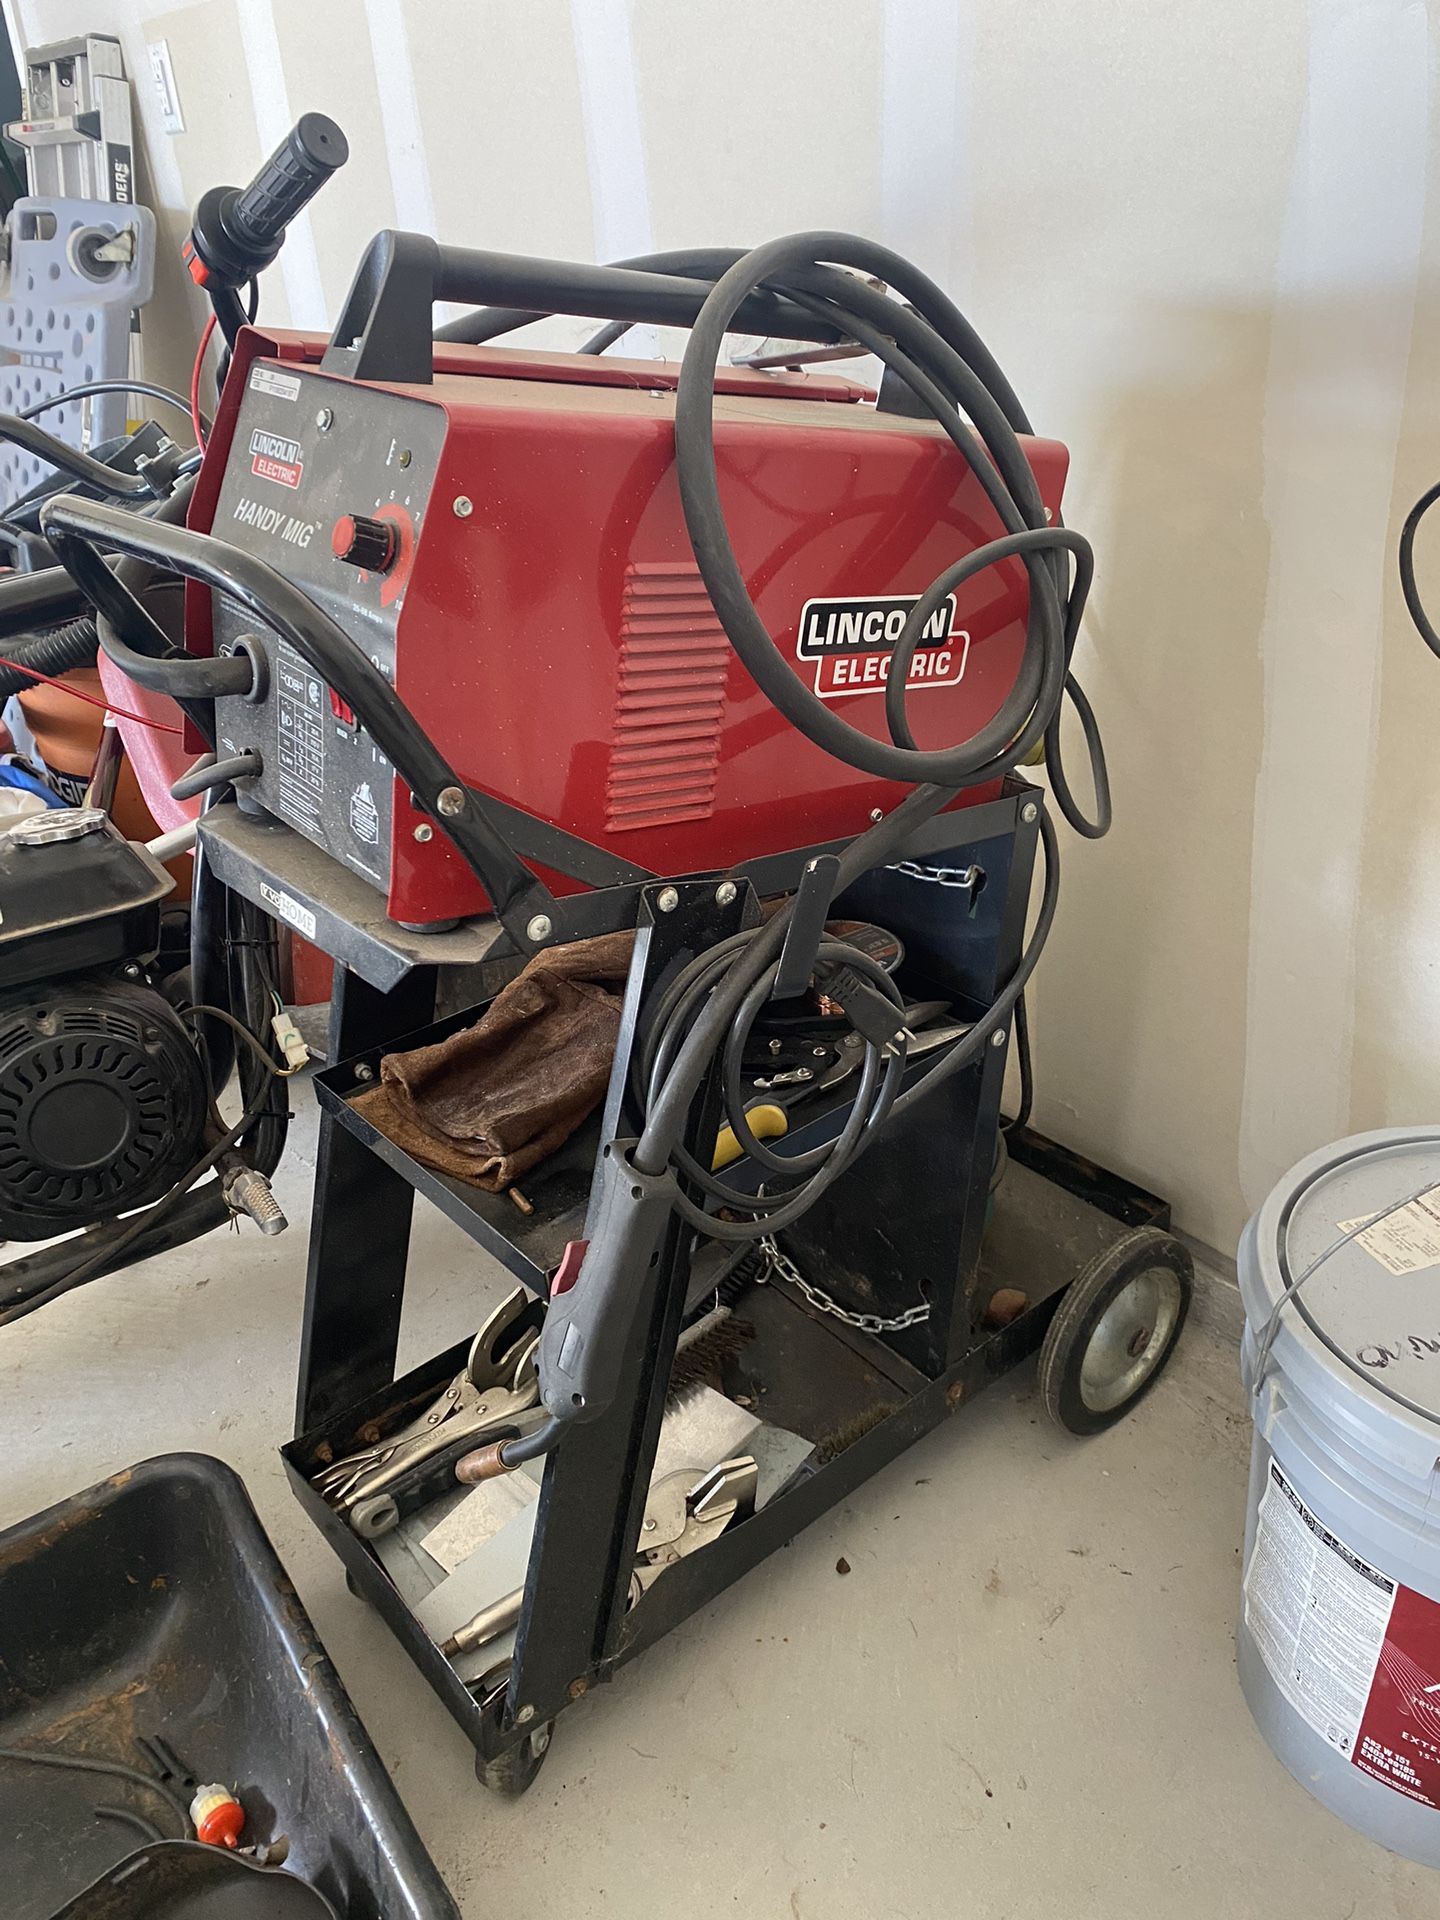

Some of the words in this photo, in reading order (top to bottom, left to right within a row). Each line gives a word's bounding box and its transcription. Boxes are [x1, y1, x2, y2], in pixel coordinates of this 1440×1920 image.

[252, 433, 297, 464] LINCOLN
[257, 459, 297, 484] ELECTRIC
[389, 489, 396, 500] 5
[404, 495, 411, 506] 6
[233, 497, 287, 535] HANDY
[807, 607, 948, 646] LINCON
[831, 651, 952, 685] ELECRIC
[1360, 1747, 1390, 1772] EXTRA
[1392, 1767, 1422, 1788] WHITE
